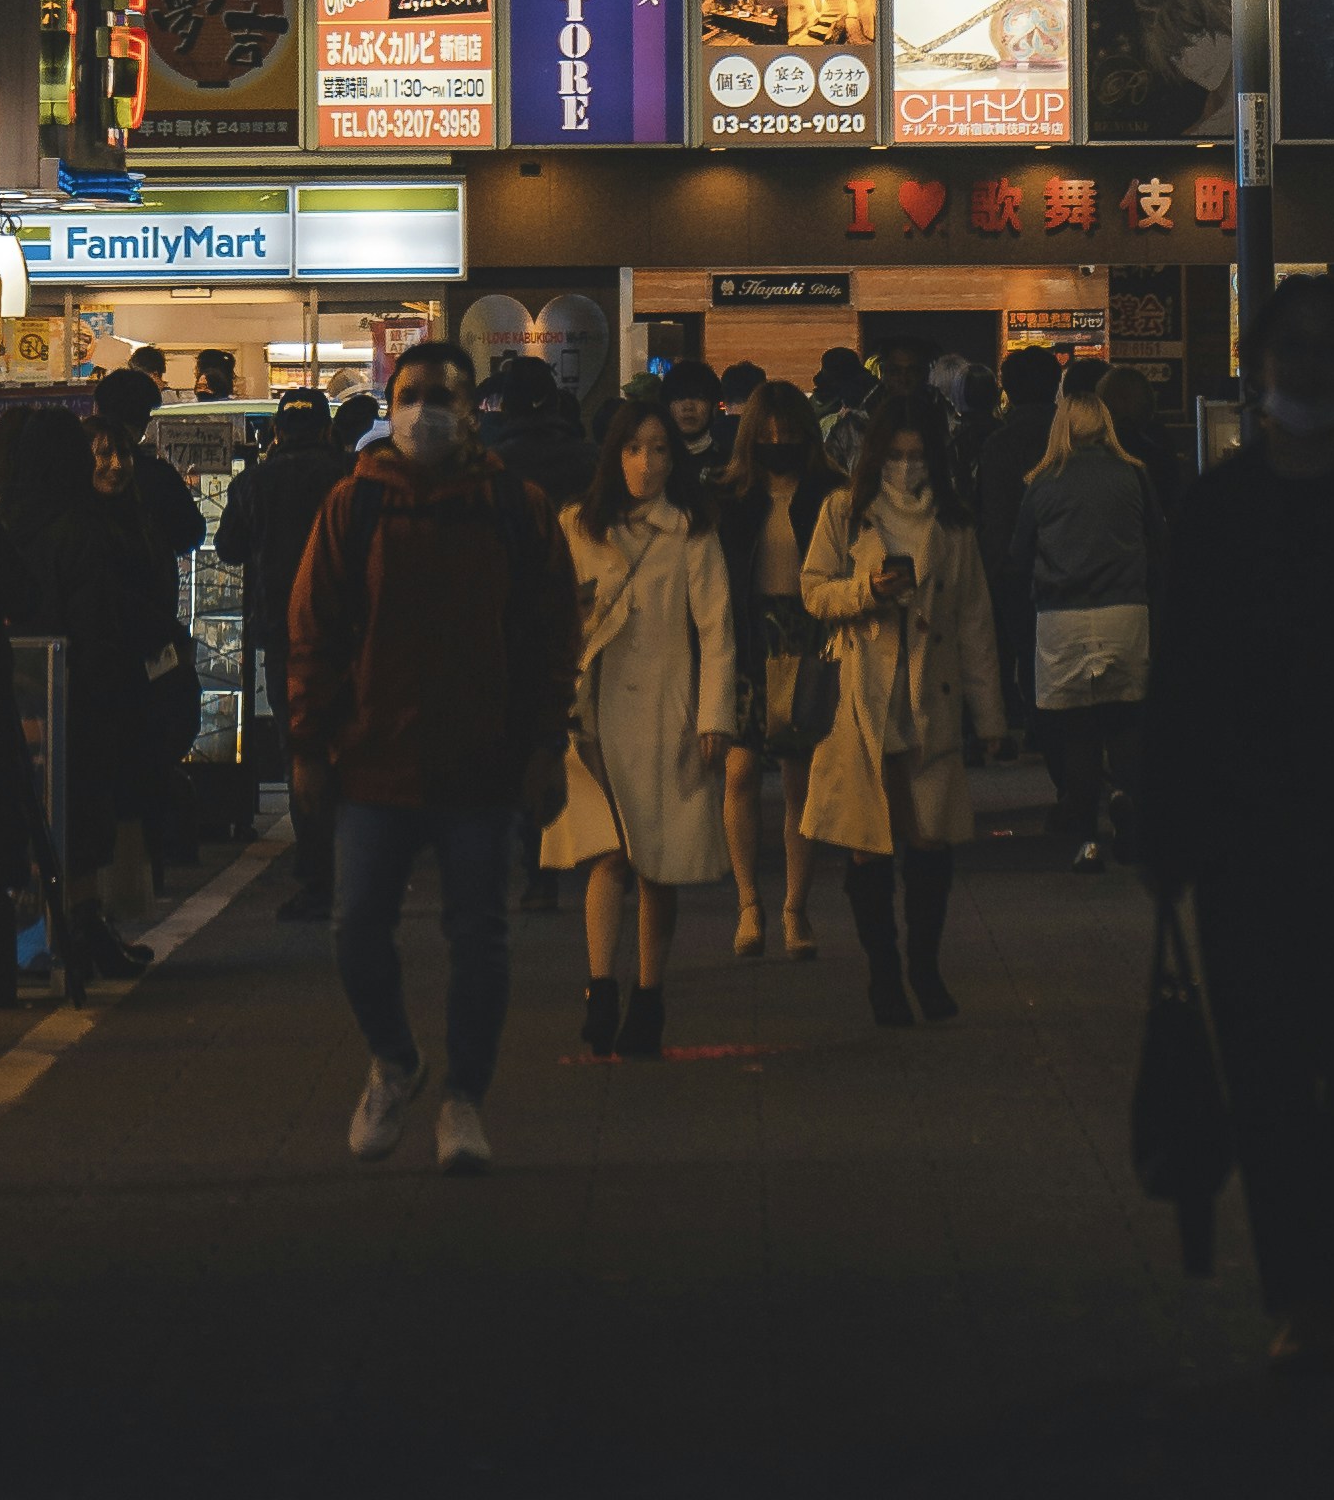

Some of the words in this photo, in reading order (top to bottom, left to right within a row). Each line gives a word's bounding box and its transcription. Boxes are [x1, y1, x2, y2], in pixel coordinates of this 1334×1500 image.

[326, 32, 436, 66] まんぷくカルビ
[715, 71, 754, 92] 個室
[774, 66, 806, 82] 宴会
[823, 67, 866, 81] カラオケ
[772, 82, 809, 96] ホール
[830, 82, 860, 100] 完備
[712, 114, 866, 134] 03-3203-9020
[67, 226, 267, 264] FamilyMart
